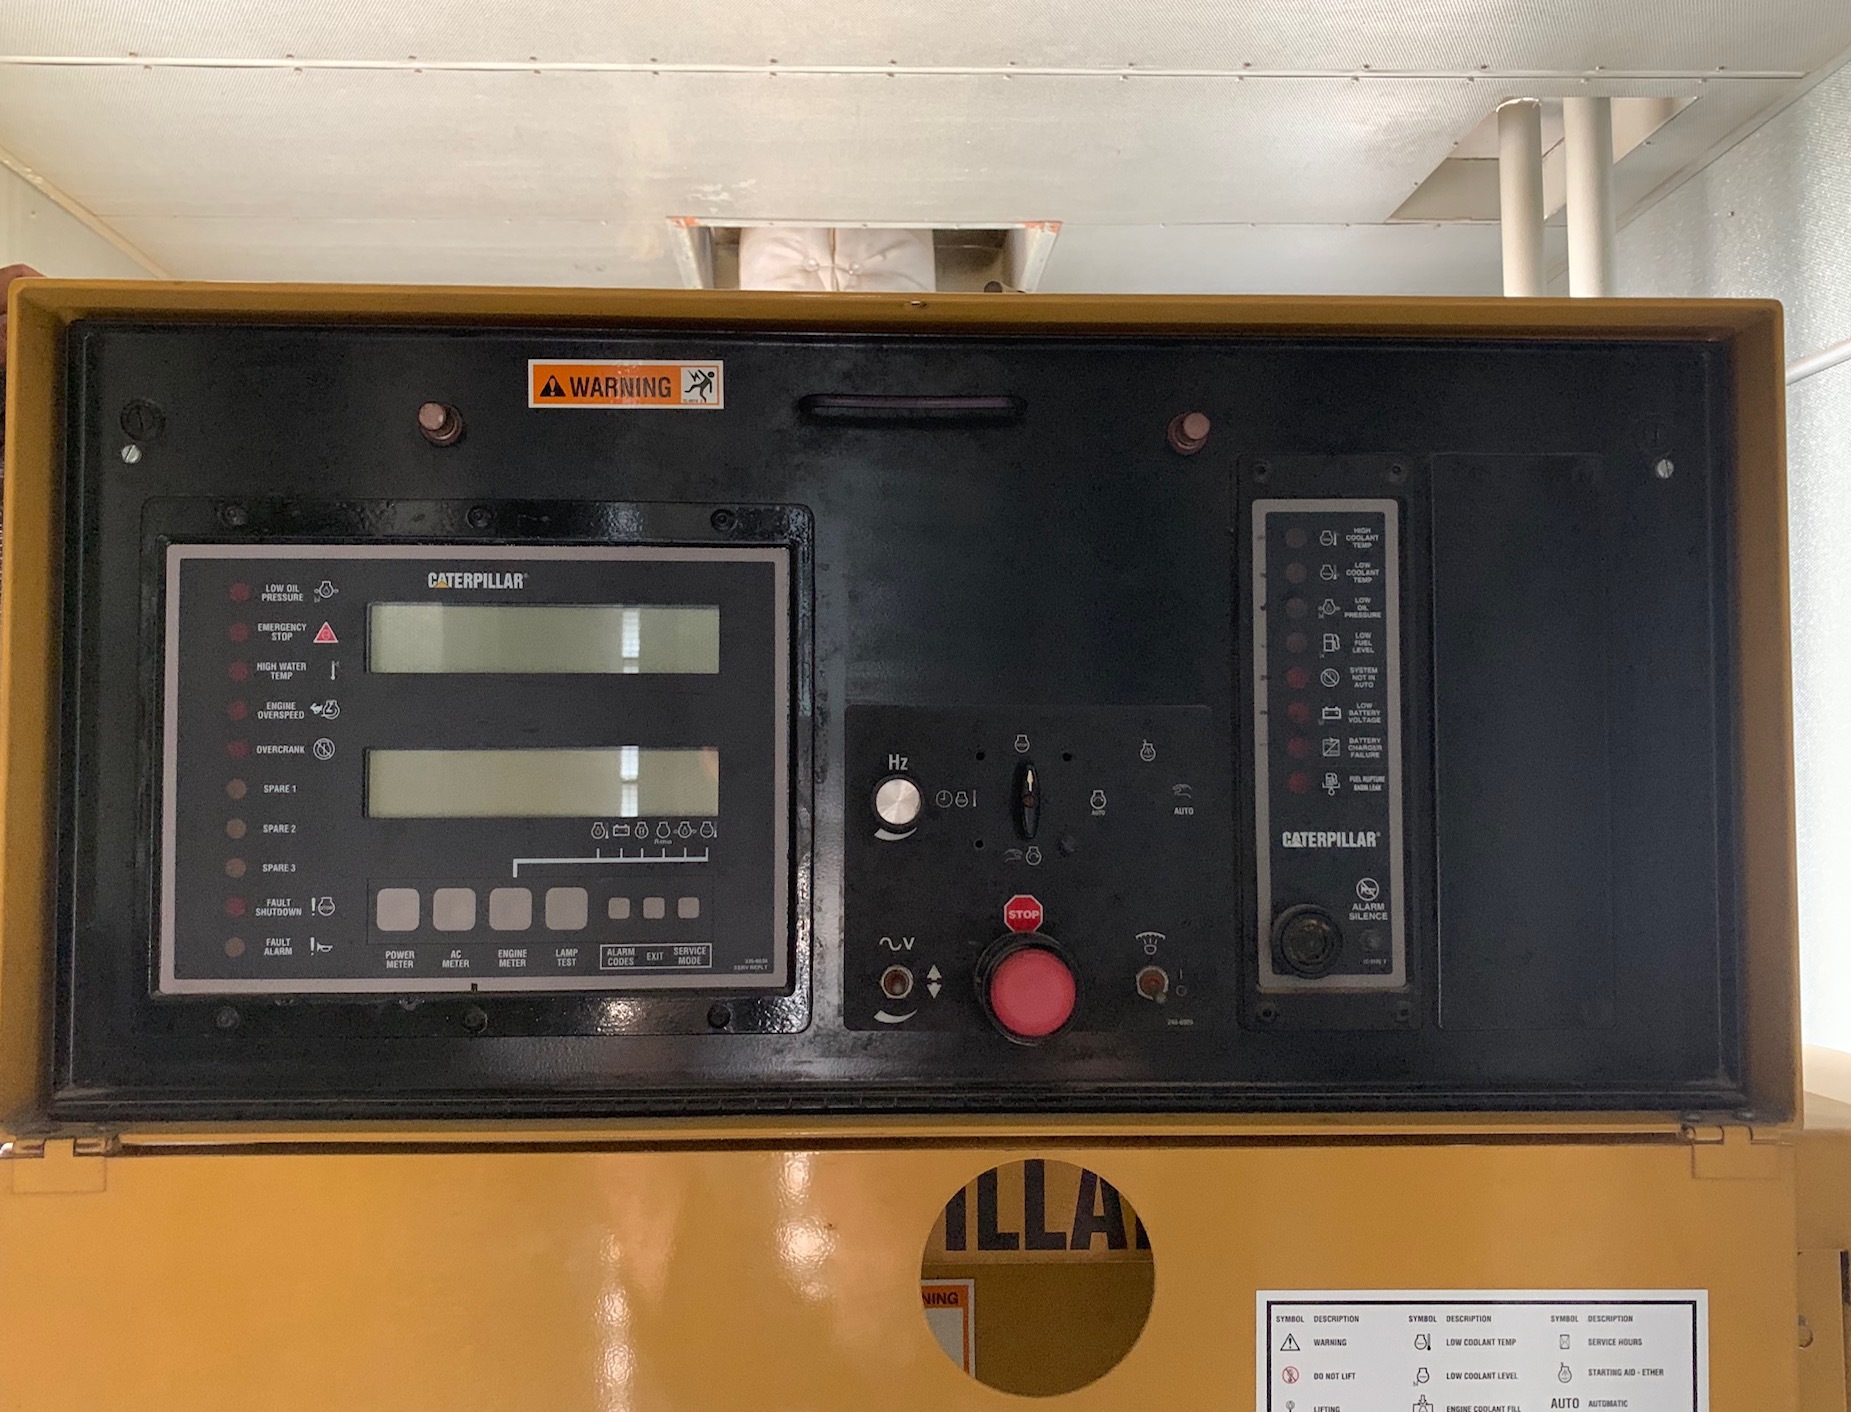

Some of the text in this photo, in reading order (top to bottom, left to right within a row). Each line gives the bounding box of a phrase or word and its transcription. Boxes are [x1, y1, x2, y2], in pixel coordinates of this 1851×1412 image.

[570, 377, 671, 398] WARNING
[428, 572, 524, 589] CATERPILLAR
[287, 584, 299, 593] OIL
[262, 593, 304, 601] PRESSURE
[258, 623, 307, 632] EMERGENCY
[271, 632, 293, 641] STOP
[271, 672, 293, 680] TEMP
[266, 702, 296, 710] ENGINE
[258, 711, 304, 719] OVERSPEED
[888, 754, 908, 770] Hz
[263, 785, 297, 793] SPARE 1
[1174, 807, 1194, 815] AUTO
[263, 825, 296, 833] SPARE 2
[1282, 832, 1377, 848] CATERPILLAR
[262, 864, 296, 872] SPARE 3
[256, 908, 302, 916] SHUTDOWN
[1008, 910, 1039, 920] STOP
[264, 947, 292, 955] ALARM
[385, 951, 415, 959] POWER
[450, 950, 462, 959] AC
[498, 949, 527, 958] ENGINE
[555, 948, 578, 958] LAMP
[607, 948, 635, 957] ALARM
[674, 947, 706, 956] SERVICE
[647, 952, 664, 961] EXIT
[678, 956, 701, 965] MODE
[386, 960, 414, 968] METER
[442, 959, 470, 968] METER
[498, 958, 526, 967] METER
[557, 958, 577, 967] TEST
[608, 957, 634, 966] CODES
[1314, 1338, 1347, 1346] WARNING
[1314, 1372, 1356, 1380] DO NOT LIFT
[1551, 1398, 1579, 1409] AUTO
[1588, 1399, 1628, 1408] AUTOMATIC
